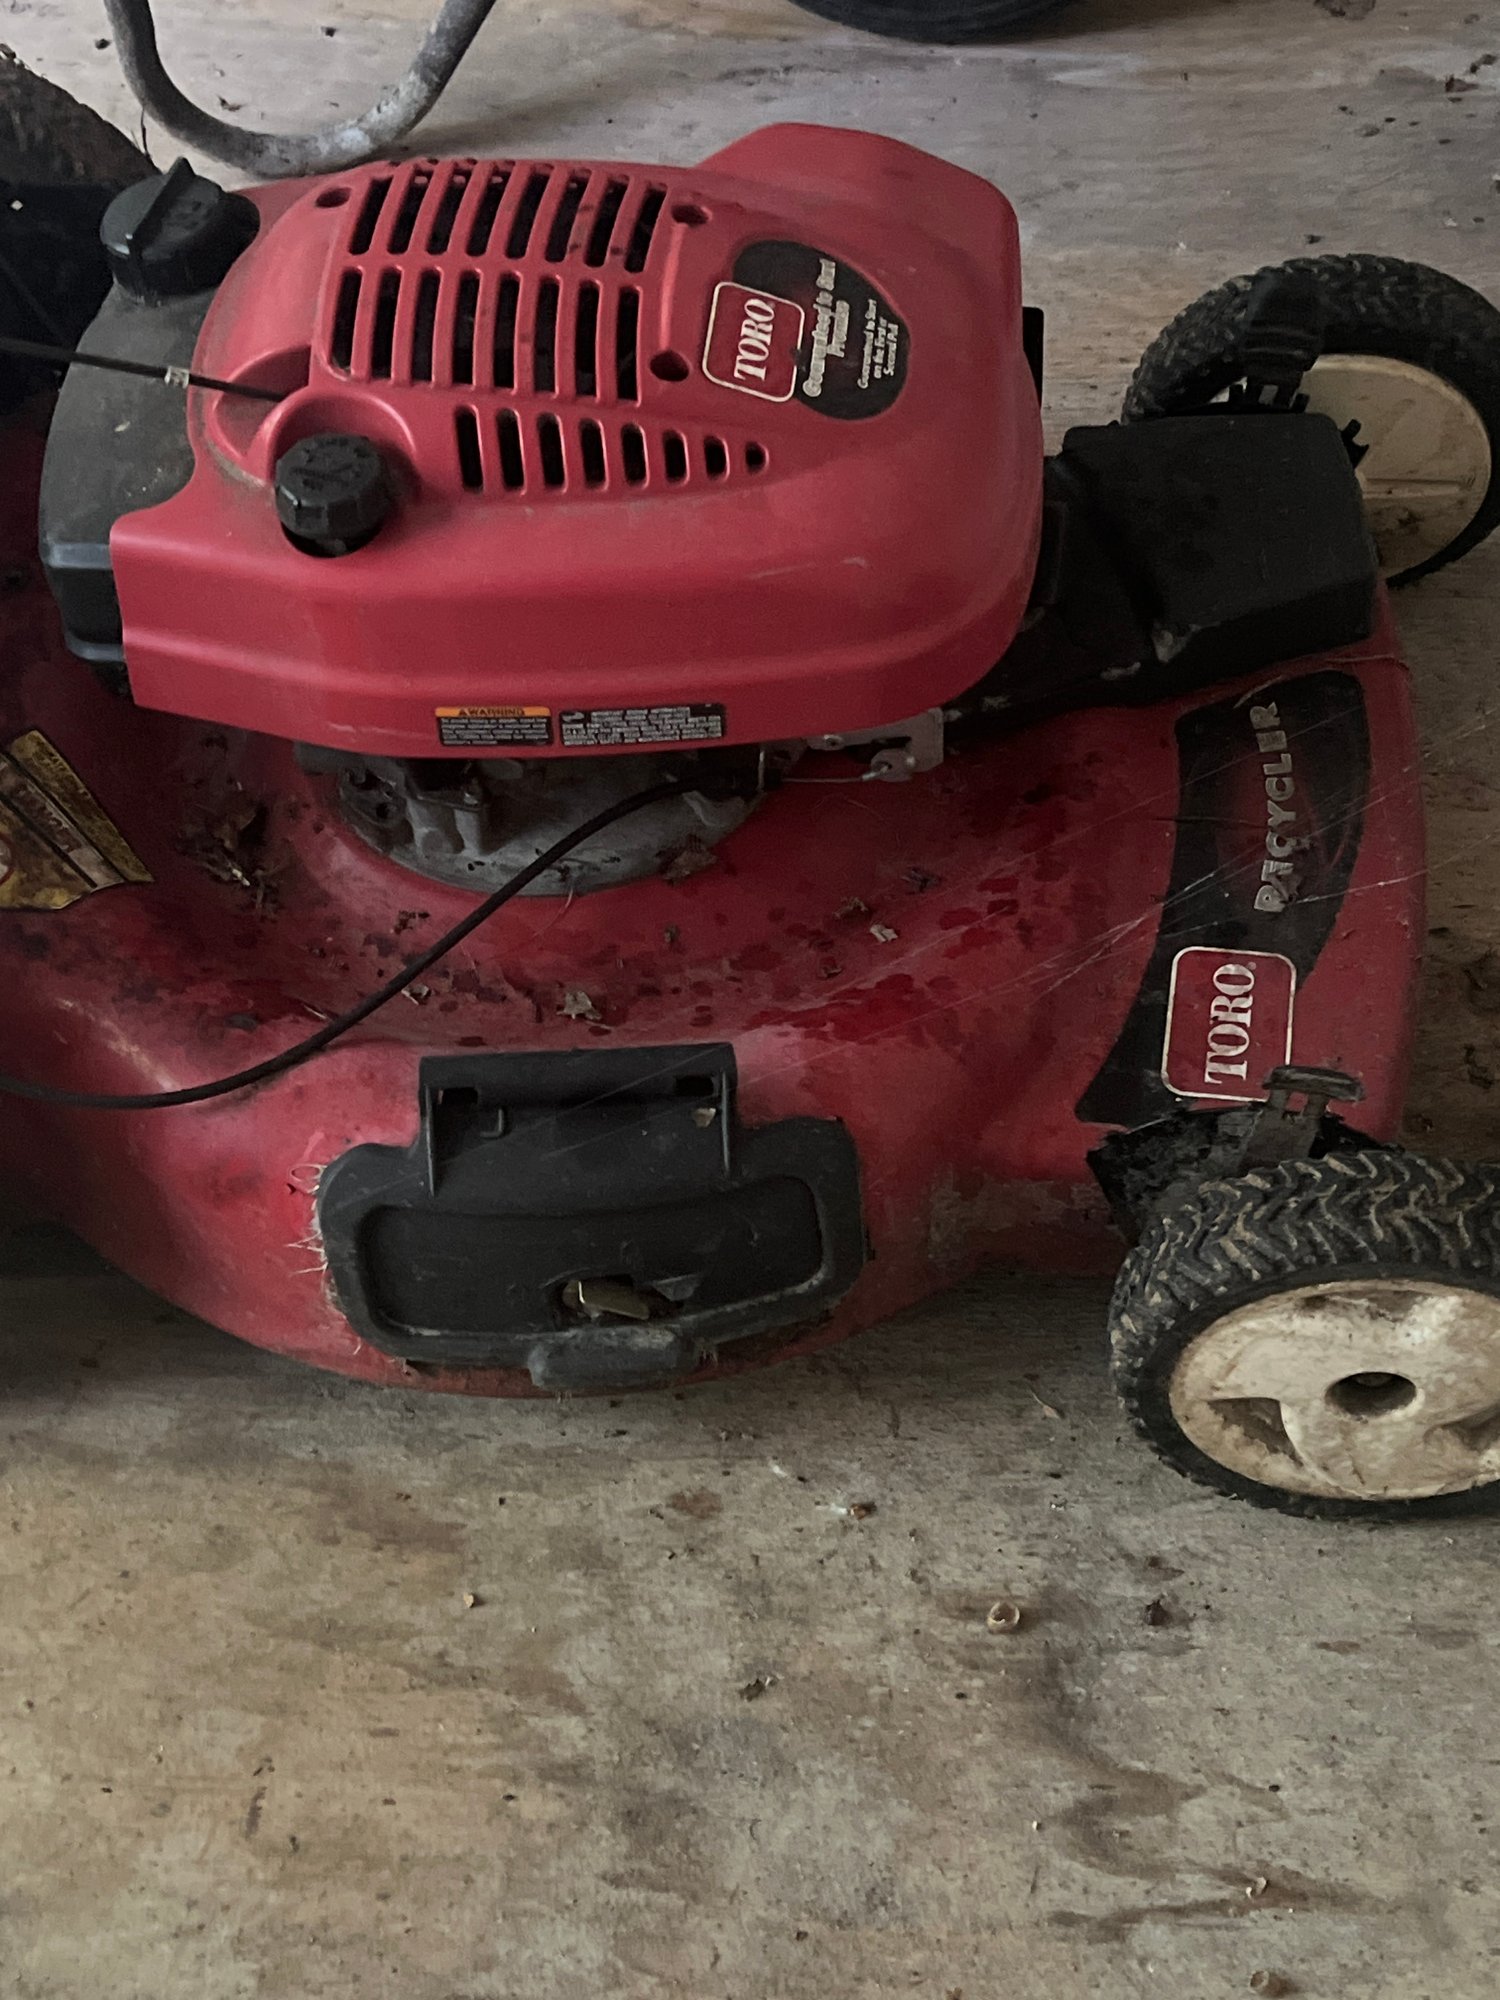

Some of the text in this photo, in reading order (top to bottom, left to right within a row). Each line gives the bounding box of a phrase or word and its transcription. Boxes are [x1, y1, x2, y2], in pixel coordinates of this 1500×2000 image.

[803, 258, 836, 397] Guaranteed to Start
[827, 300, 849, 357] Promise
[865, 299, 877, 320] Start
[734, 298, 775, 381] TORO
[857, 331, 874, 389] Guaranteed
[883, 323, 899, 376] Second Pull
[466, 707, 525, 717] WARNING
[1204, 963, 1255, 1084] TORO
